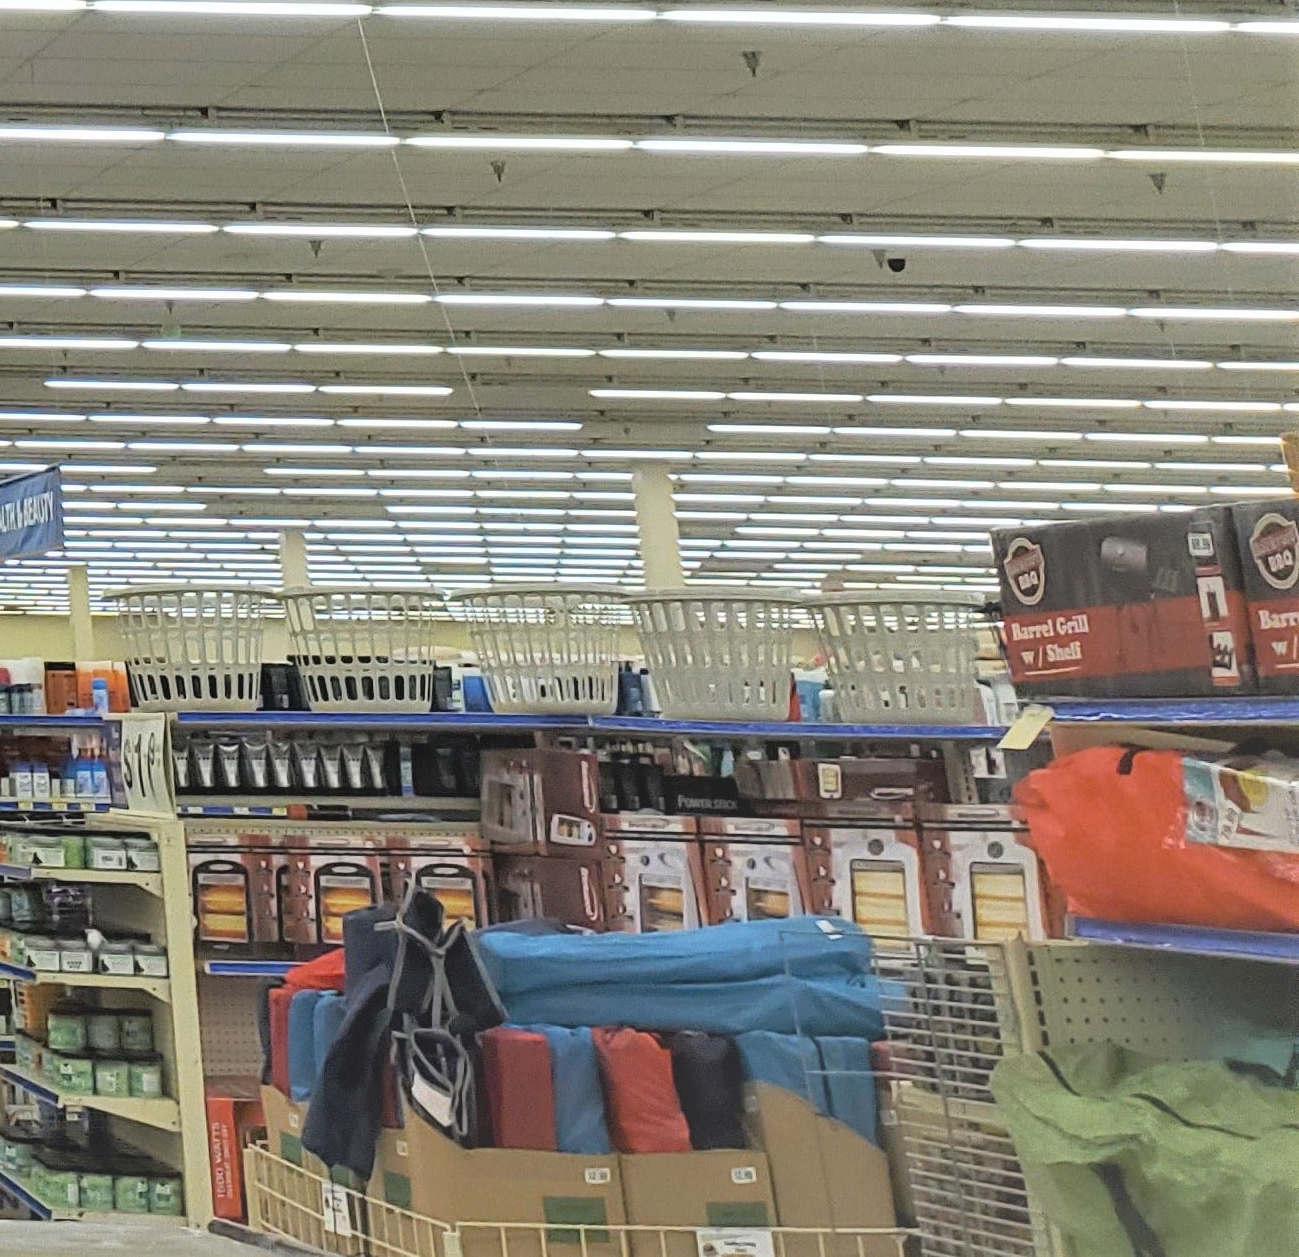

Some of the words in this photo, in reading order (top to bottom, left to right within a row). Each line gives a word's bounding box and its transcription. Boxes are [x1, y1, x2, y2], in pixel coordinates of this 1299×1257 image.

[23, 491, 54, 527] BEAUTY
[1267, 549, 1293, 573] BBQ
[1011, 619, 1054, 641] Barrel
[1056, 614, 1089, 636] Grill
[1046, 640, 1082, 663] Shelf
